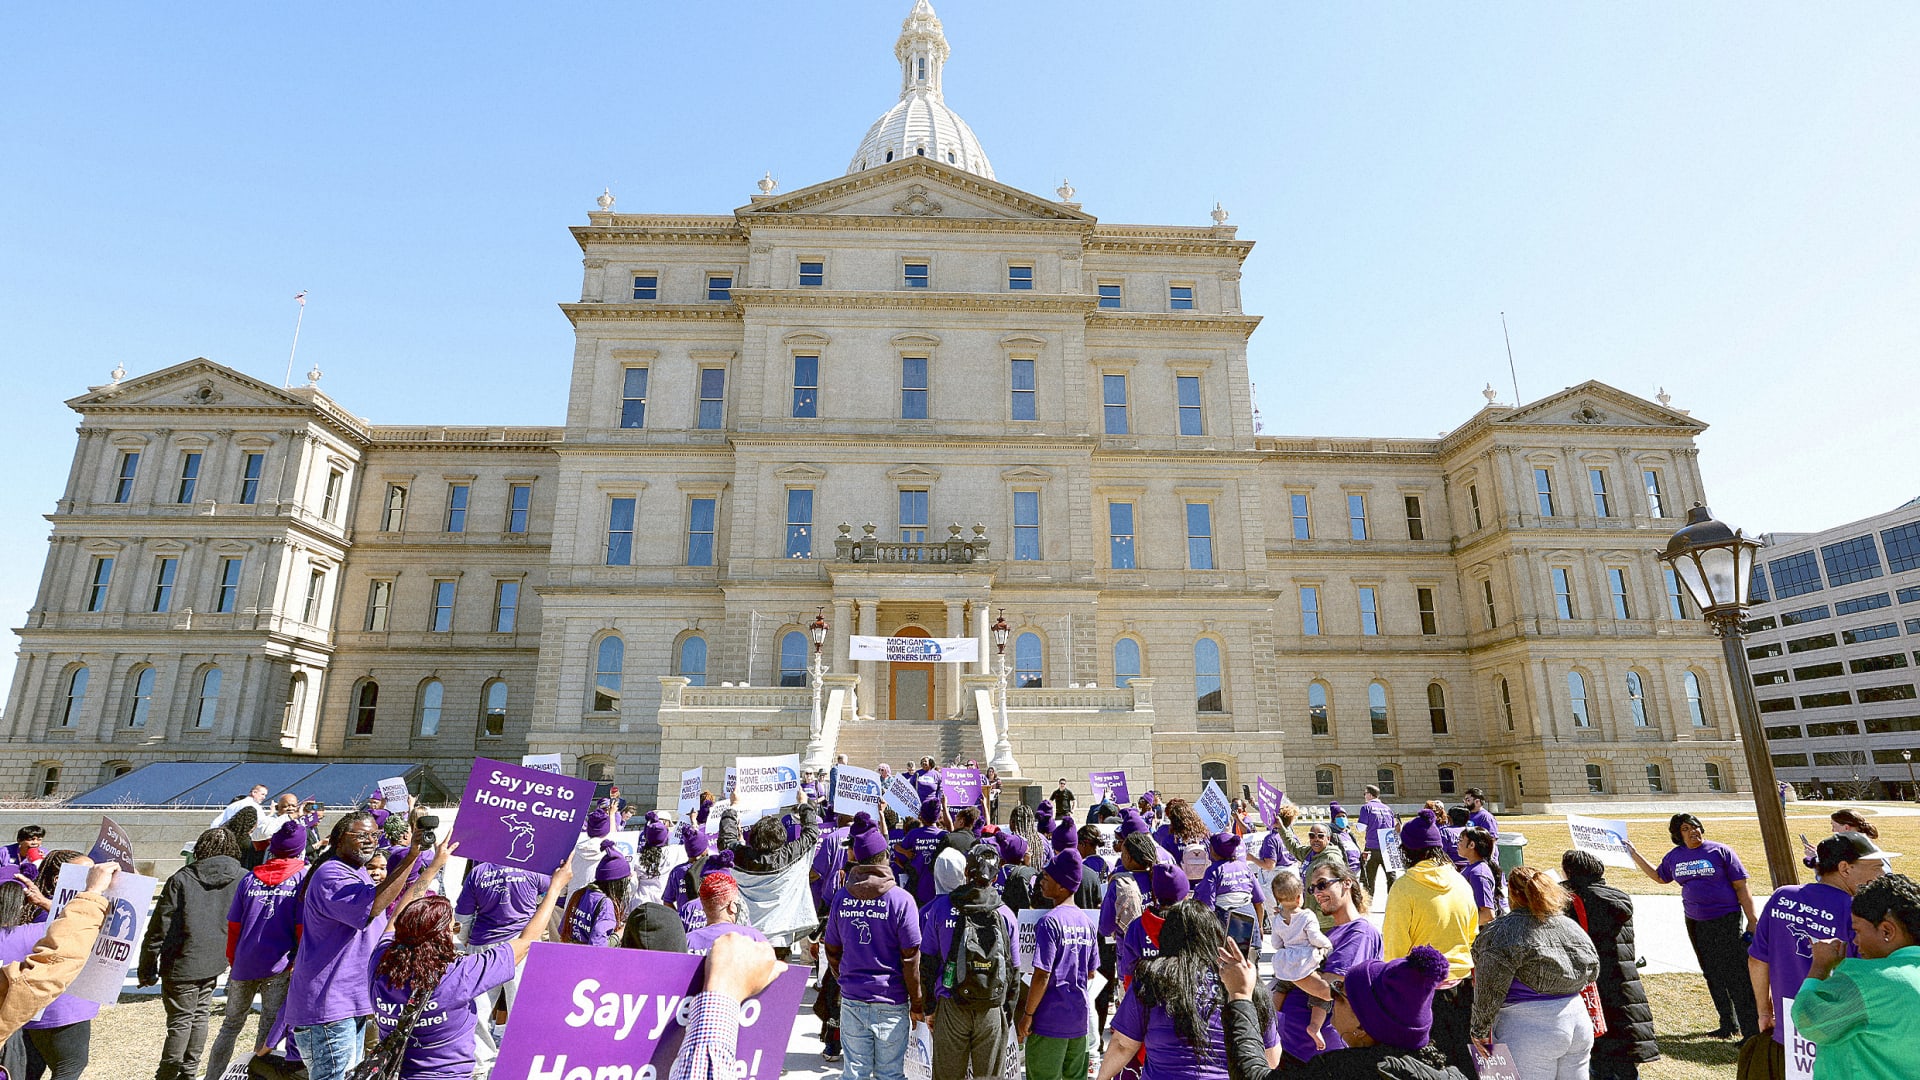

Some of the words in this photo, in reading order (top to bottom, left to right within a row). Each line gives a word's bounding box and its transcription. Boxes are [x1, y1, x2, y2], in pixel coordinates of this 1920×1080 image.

[740, 767, 778, 775] MICHIGAN
[489, 770, 522, 792] Say
[523, 781, 554, 796] yes
[557, 786, 574, 800] to
[740, 776, 759, 784] HOME
[840, 774, 868, 785] MICHIGAN
[740, 784, 773, 792] WORKERS
[774, 781, 797, 791] UNITED
[838, 782, 852, 790] HOME
[853, 785, 867, 793] CARE
[838, 790, 861, 800] WORKERS
[475, 789, 527, 812] Home
[532, 802, 576, 822] Care!
[908, 803, 920, 815] UNITE
[108, 826, 118, 842] Say
[1572, 824, 1606, 835] MICHIGAN
[1574, 832, 1592, 841] HOME
[1576, 840, 1606, 850] WORKERS
[100, 838, 121, 857] Home
[122, 851, 133, 865] Car
[483, 869, 498, 878] Say
[253, 879, 266, 887] Sa
[481, 878, 503, 888] Home
[274, 888, 296, 897] Care!
[842, 898, 858, 908] Say
[860, 898, 875, 908] yes
[878, 899, 886, 907] to
[1778, 896, 1797, 909] Say
[1798, 903, 1819, 916] yes
[1821, 910, 1834, 920] to
[840, 909, 864, 918] Home
[866, 910, 889, 920] Care!
[950, 908, 960, 916] Sa
[578, 920, 591, 933] Care
[945, 920, 956, 928] Ho
[1771, 908, 1804, 924] Home
[1805, 917, 1836, 936] Care!
[1019, 934, 1036, 944] HOM
[95, 937, 131, 962] UNITED
[1143, 948, 1159, 957] Ho
[1206, 972, 1218, 980] es
[375, 997, 397, 1015] Say
[426, 1001, 438, 1011] to
[564, 978, 648, 1041] Say
[648, 994, 693, 1040] ye
[739, 999, 761, 1028] o
[375, 1012, 398, 1027] Hom
[1794, 1039, 1816, 1057] HO
[1496, 1054, 1506, 1066] to
